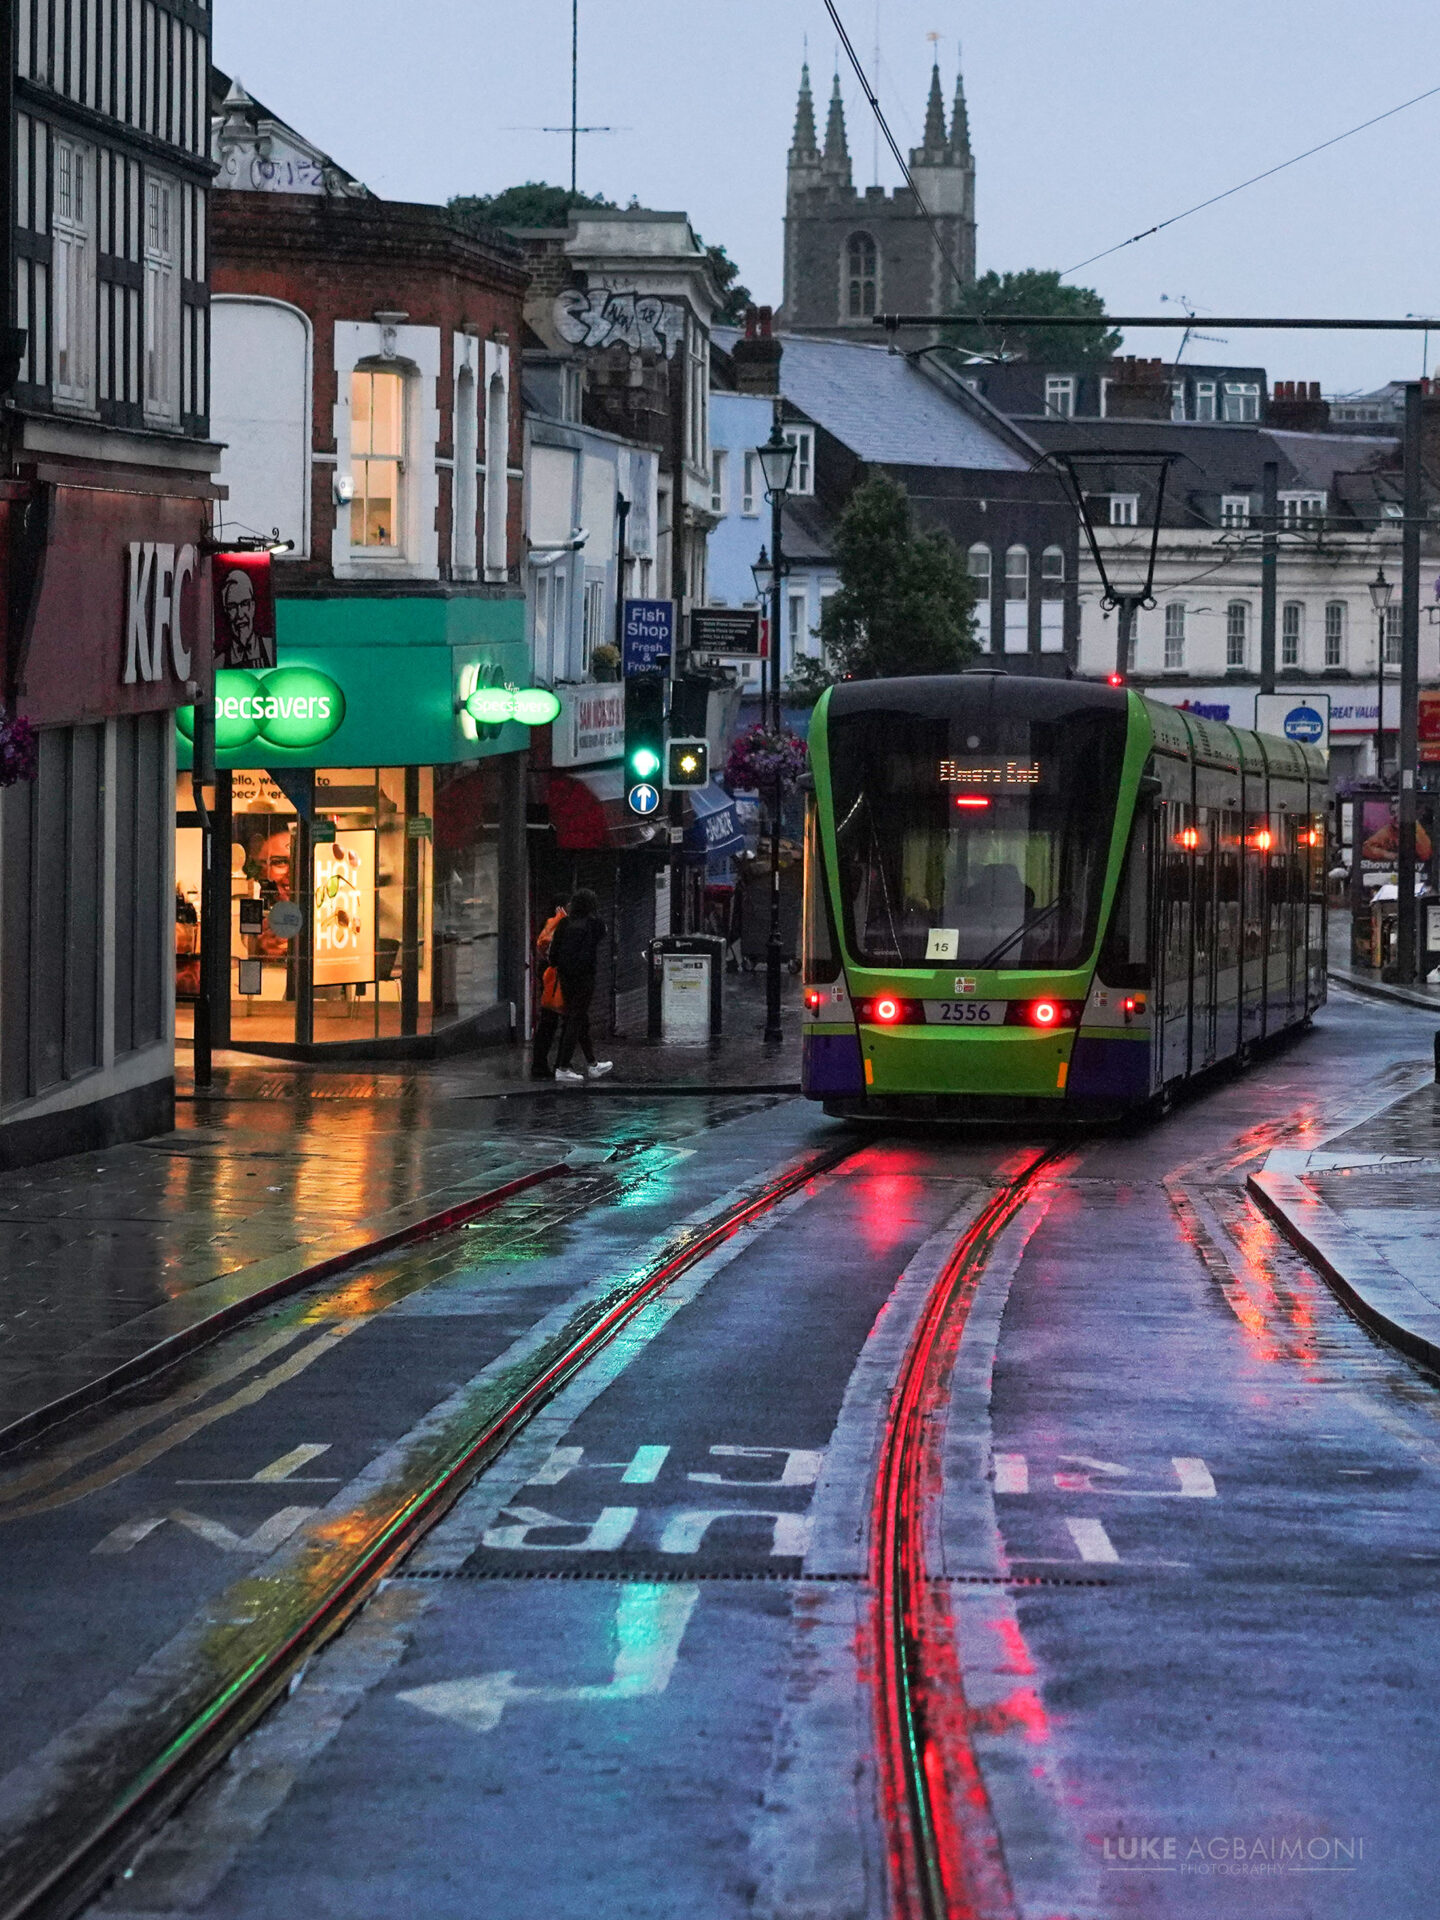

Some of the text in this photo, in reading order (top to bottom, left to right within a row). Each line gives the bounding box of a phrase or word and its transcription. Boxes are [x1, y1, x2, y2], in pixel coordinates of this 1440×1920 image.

[123, 541, 198, 684] KFC
[632, 608, 665, 622] Fish
[627, 622, 669, 640] Shop
[632, 642, 663, 652] Fresh
[215, 696, 330, 719] ecsavers
[474, 698, 551, 714] Specsavers
[1330, 706, 1354, 719] REAT
[940, 761, 1039, 783] Elmers End
[232, 775, 255, 786] ello,
[317, 776, 330, 786] to
[1360, 860, 1390, 869] Show
[934, 942, 949, 952] 15
[940, 1003, 990, 1021] 2556
